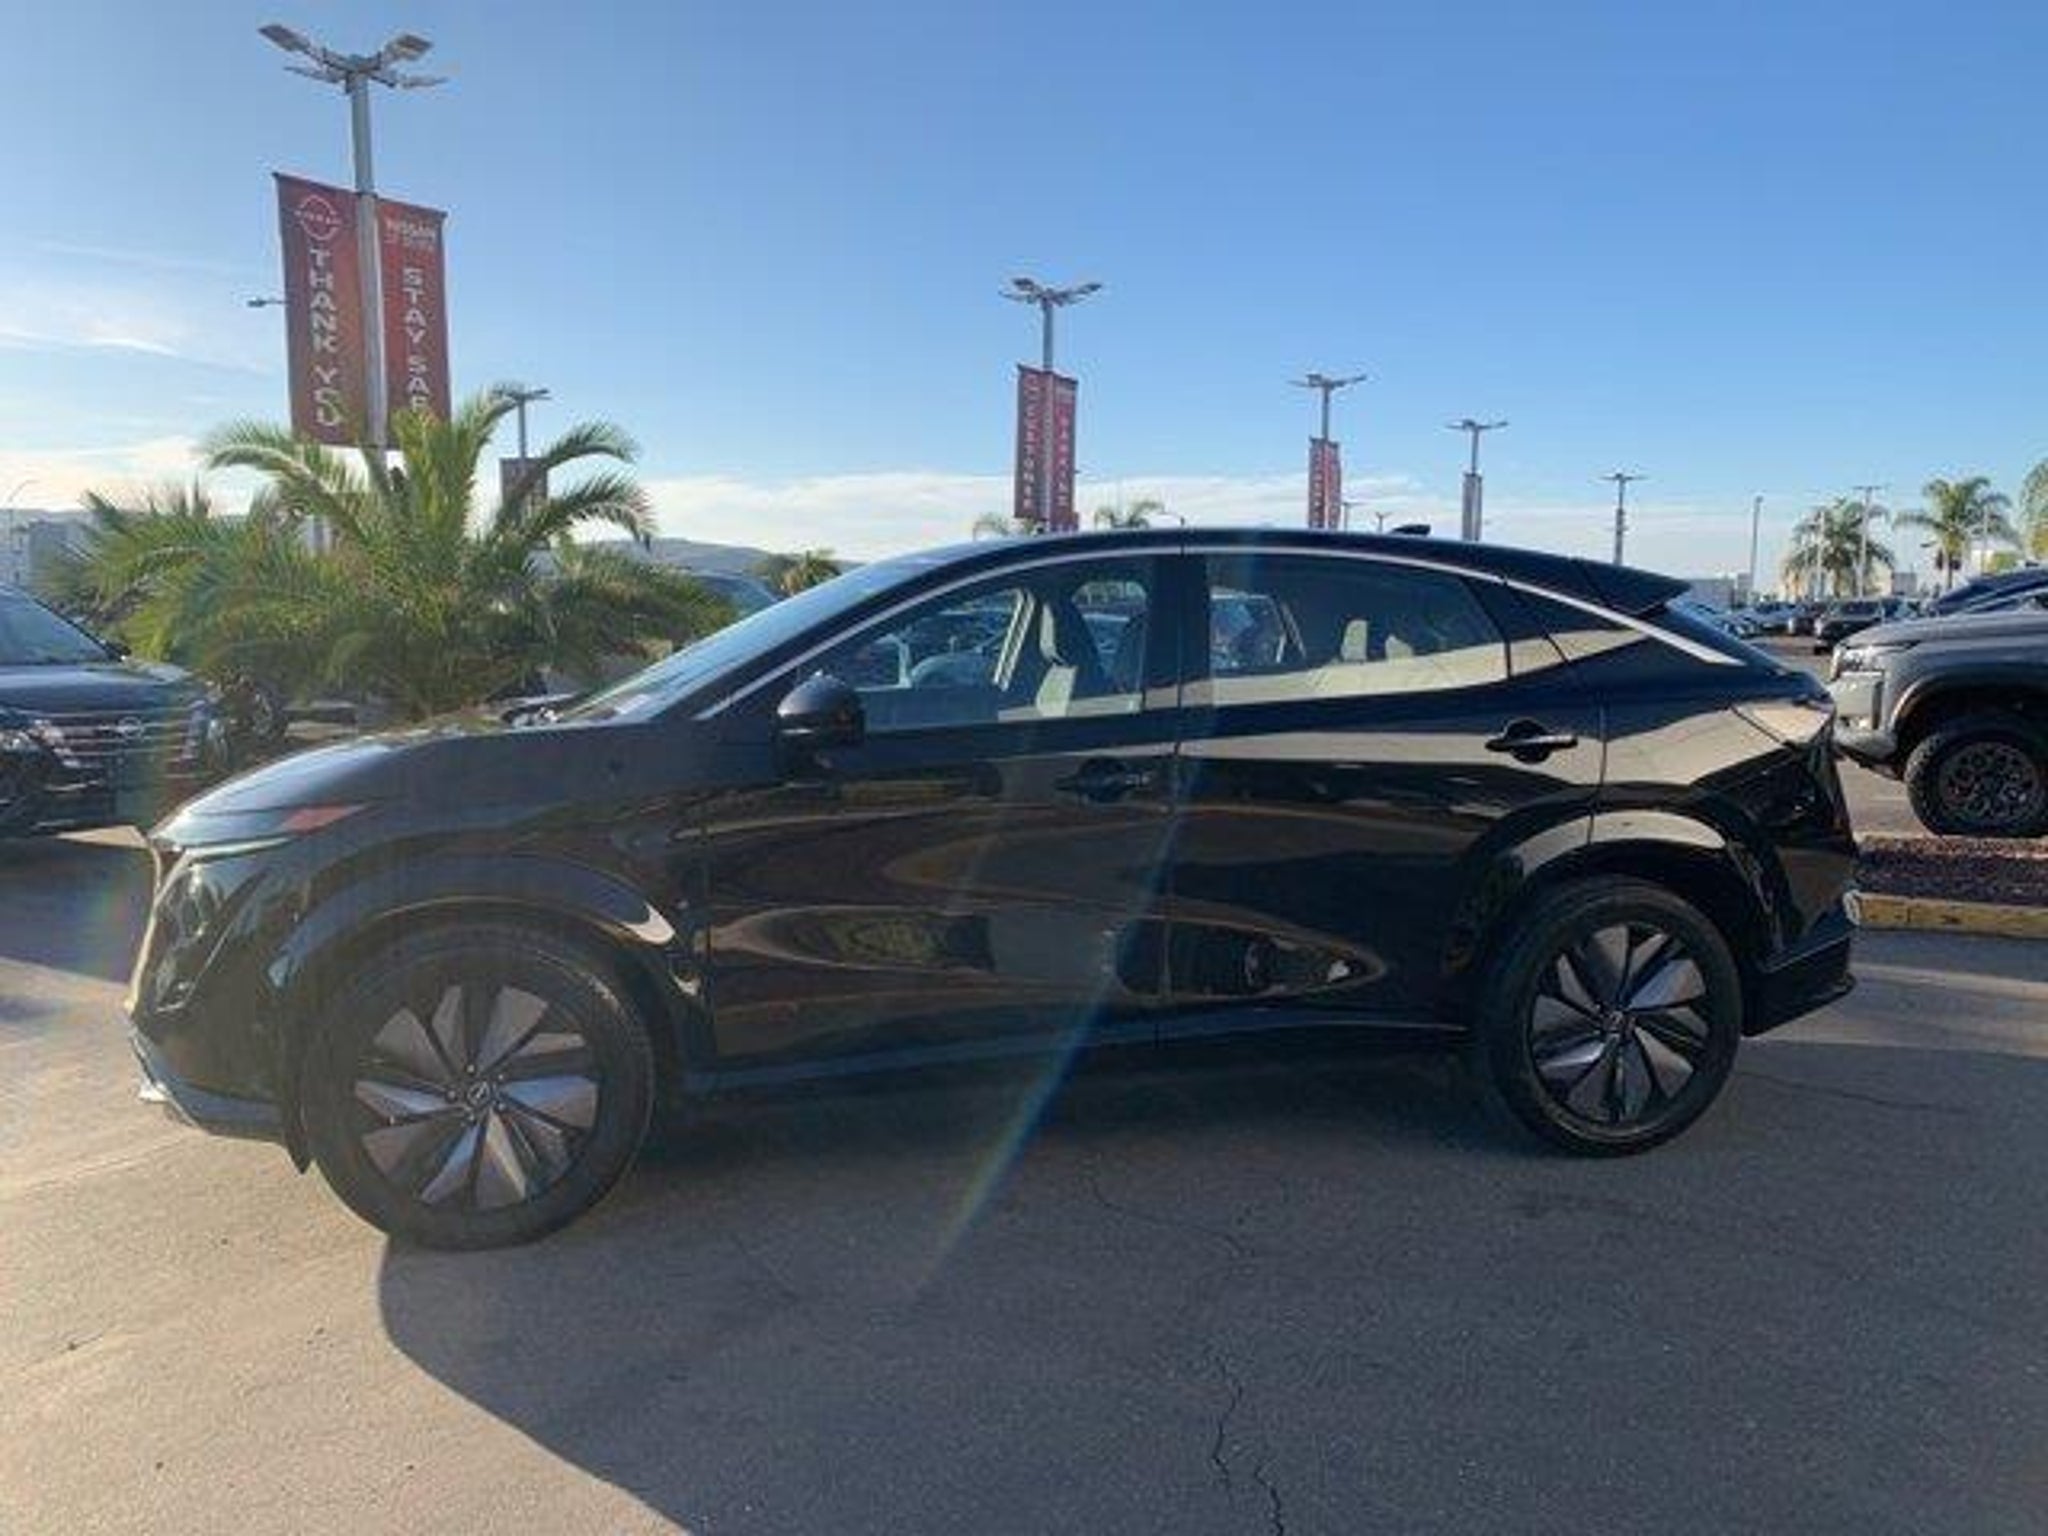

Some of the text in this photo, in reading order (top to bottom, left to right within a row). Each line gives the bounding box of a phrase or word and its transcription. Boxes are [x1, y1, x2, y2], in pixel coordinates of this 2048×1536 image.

[309, 249, 338, 352] THANK
[402, 268, 427, 344] STAY
[314, 366, 342, 426] YOU
[407, 355, 429, 416] SAF
